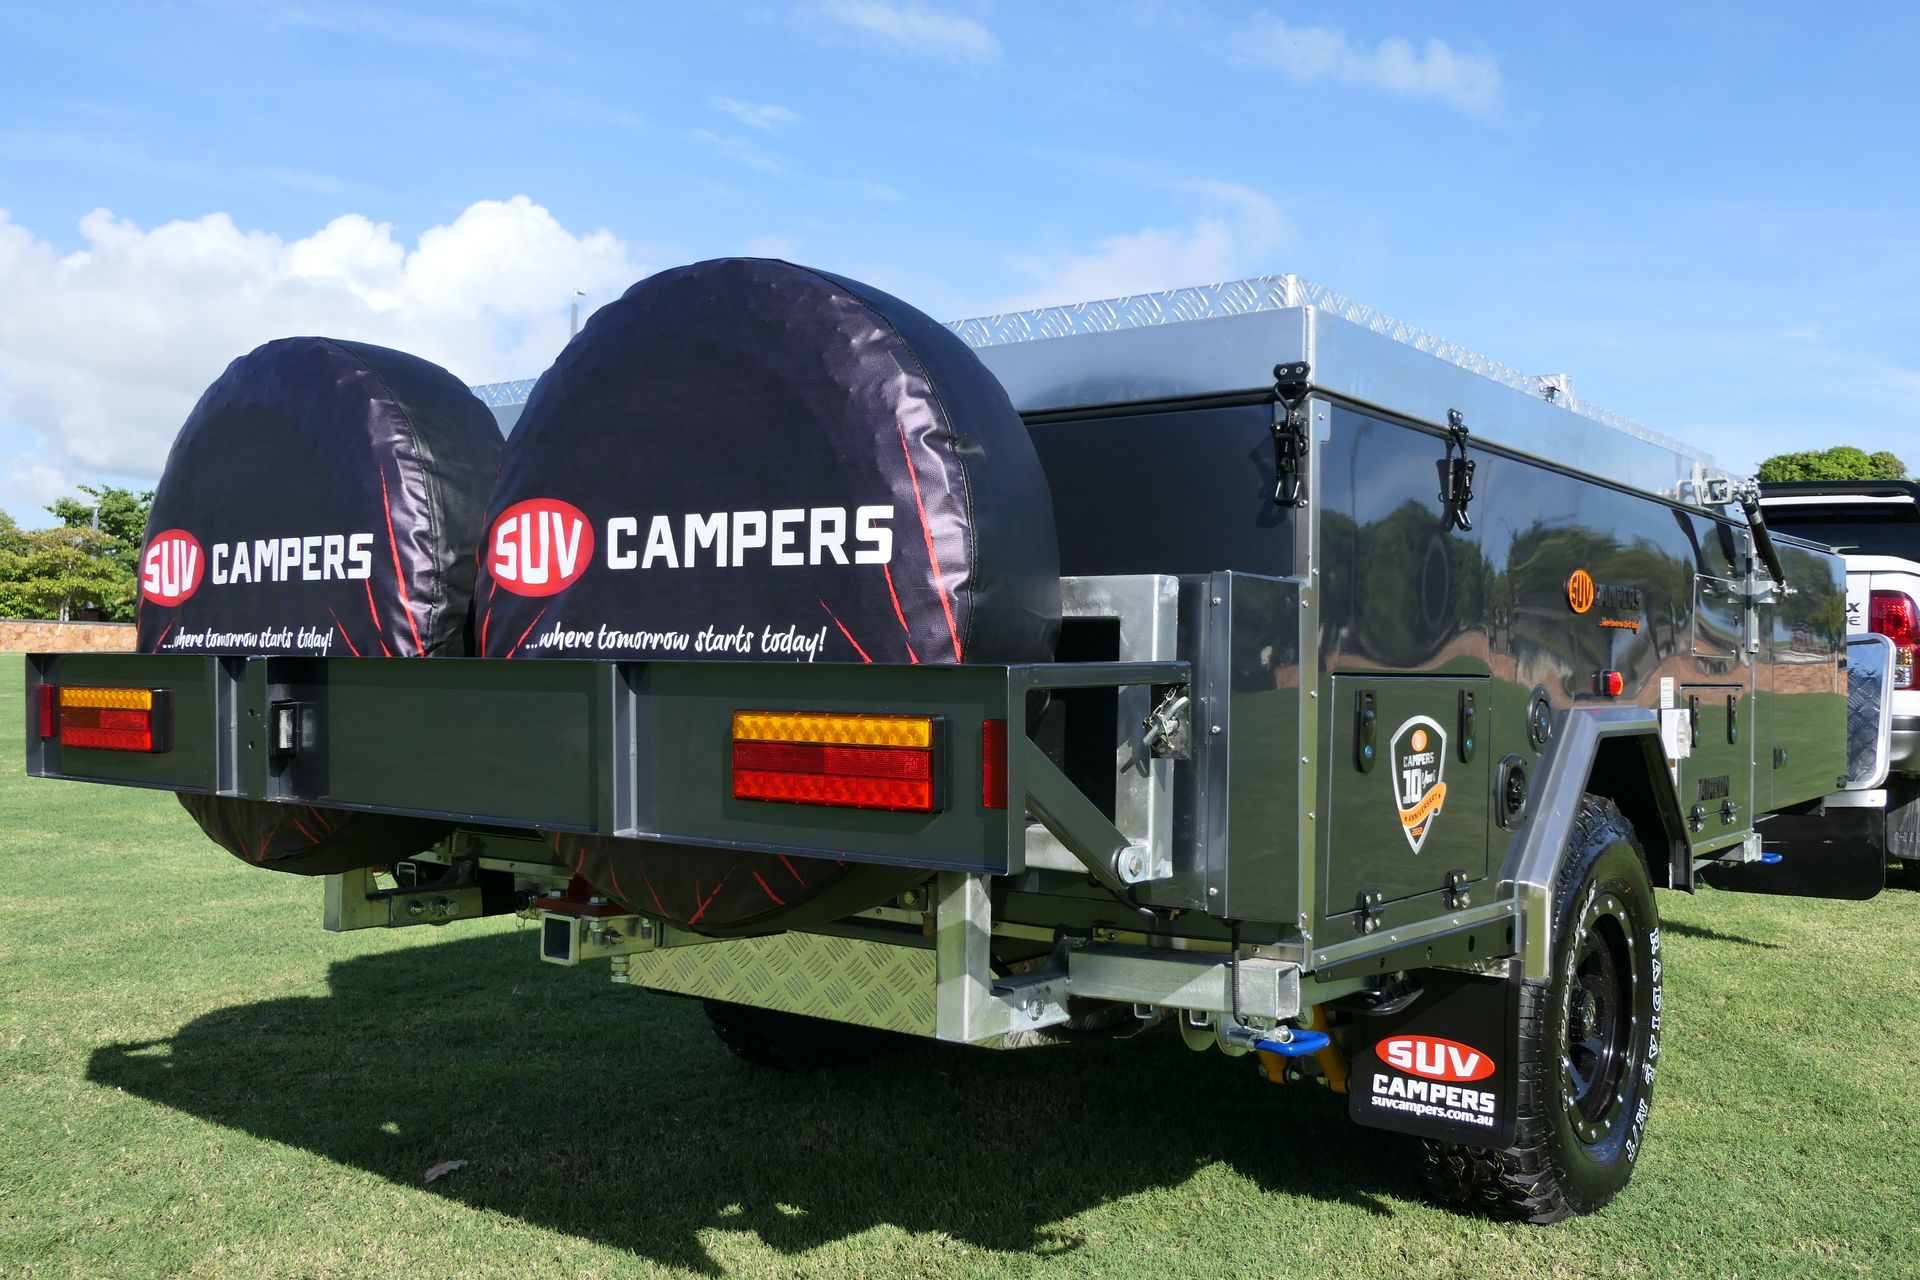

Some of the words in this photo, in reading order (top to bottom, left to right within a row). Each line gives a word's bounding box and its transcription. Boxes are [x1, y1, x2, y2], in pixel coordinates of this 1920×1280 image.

[493, 511, 583, 584] SUV
[607, 505, 894, 569] CAMPERS
[144, 539, 198, 597] SUV
[212, 533, 374, 585] CAMPERS
[1571, 574, 1591, 609] SUV
[204, 629, 258, 650] tomorrow
[259, 628, 294, 650] starts
[297, 626, 333, 655] today!
[597, 622, 689, 651] tomorrow
[695, 624, 754, 653] starts
[761, 626, 828, 663] today!
[1403, 752, 1434, 767] CAMPERS
[1402, 769, 1421, 804] 10
[1643, 927, 1662, 1085] RADIAL
[1388, 1040, 1480, 1077] SUV
[1371, 1095, 1494, 1127] suvcampers.com.au
[1372, 1073, 1495, 1114] CAMPERS
